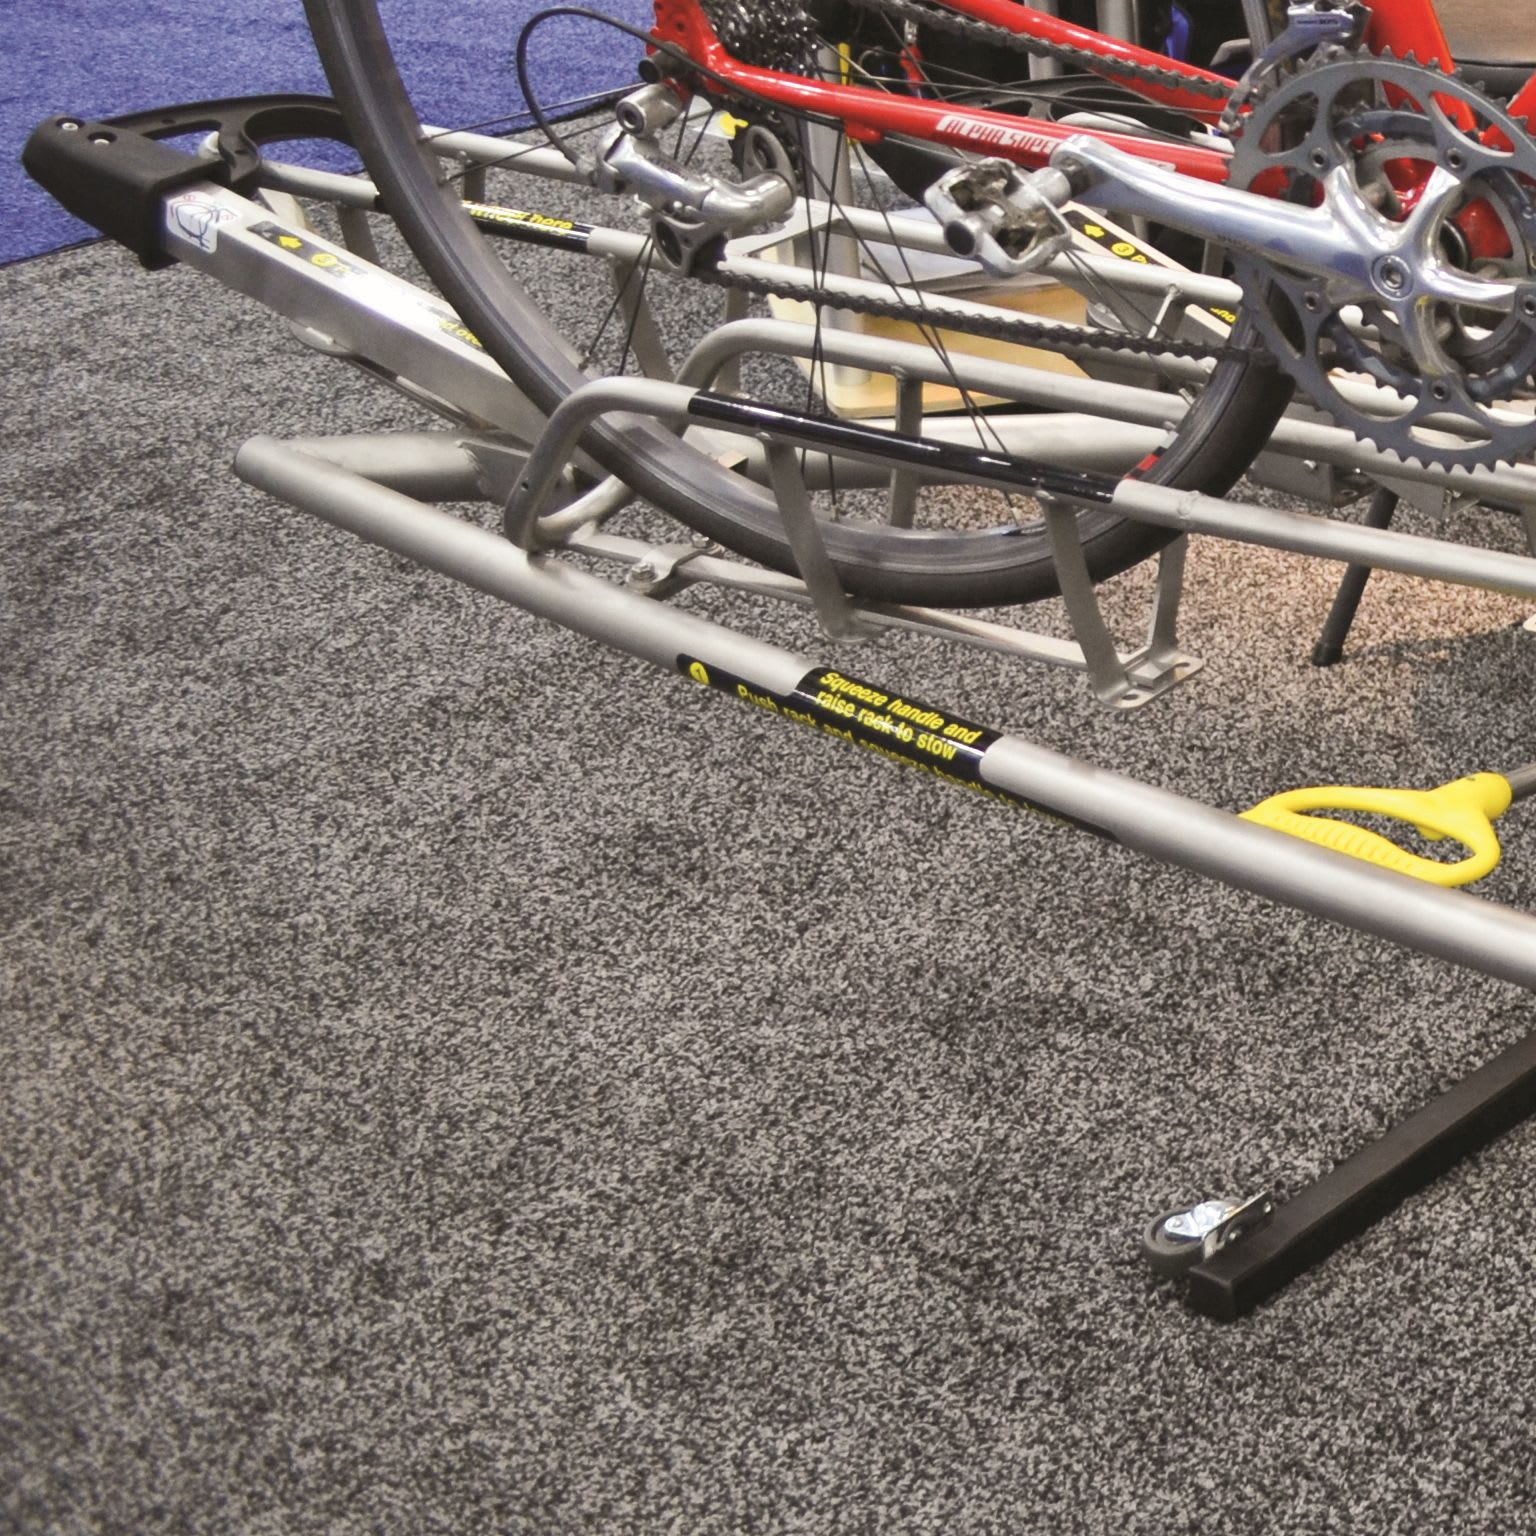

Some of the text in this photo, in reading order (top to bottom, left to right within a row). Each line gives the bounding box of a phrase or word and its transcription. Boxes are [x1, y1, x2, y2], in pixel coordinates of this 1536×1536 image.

[815, 691, 856, 718] raise
[857, 708, 895, 735] rack
[916, 732, 957, 761] stow
[820, 672, 983, 745] Squeeze handle and
